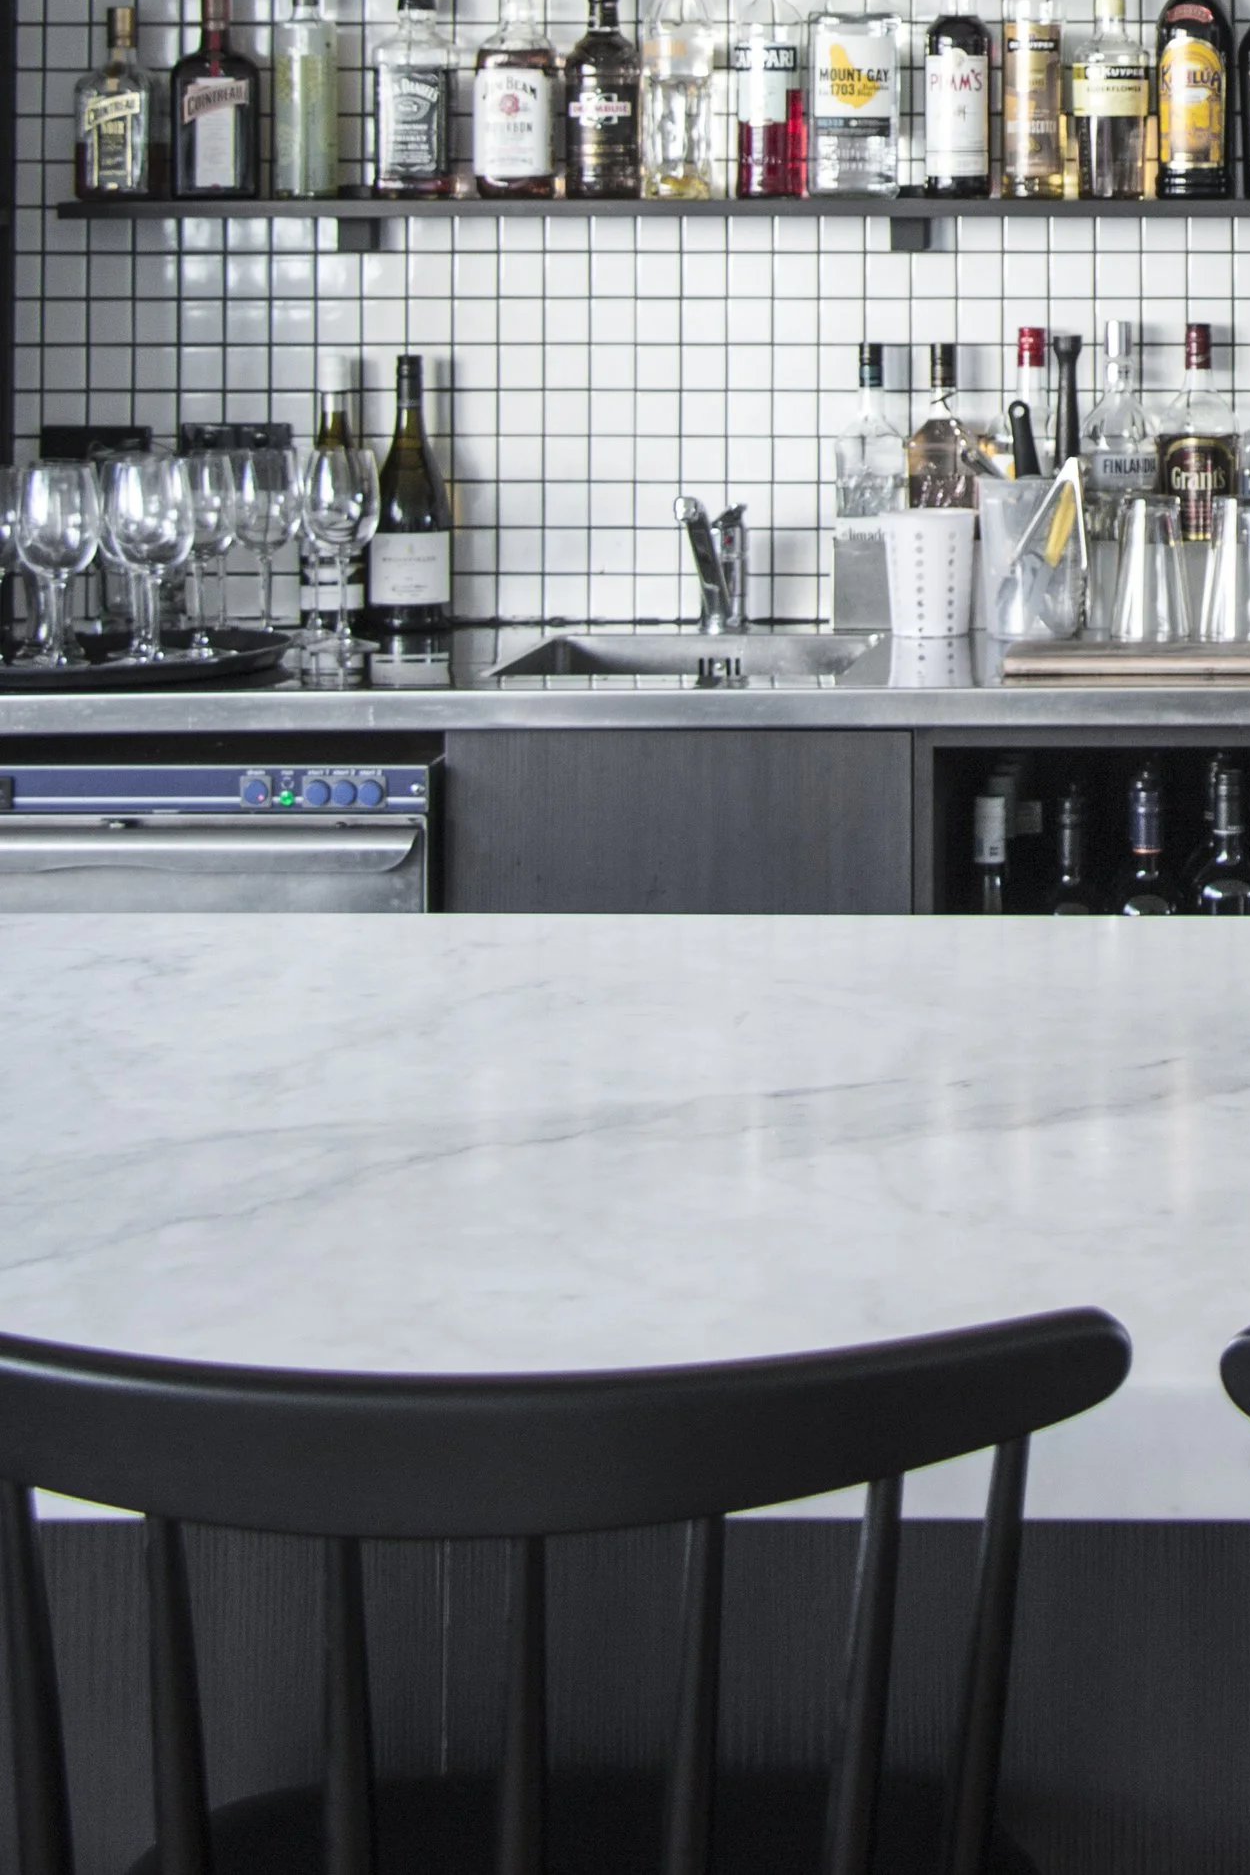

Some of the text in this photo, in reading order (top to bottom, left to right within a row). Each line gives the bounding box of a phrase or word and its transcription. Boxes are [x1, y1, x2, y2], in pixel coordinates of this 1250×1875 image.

[819, 68, 889, 82] MOUNT GAY
[830, 83, 855, 96] 1703
